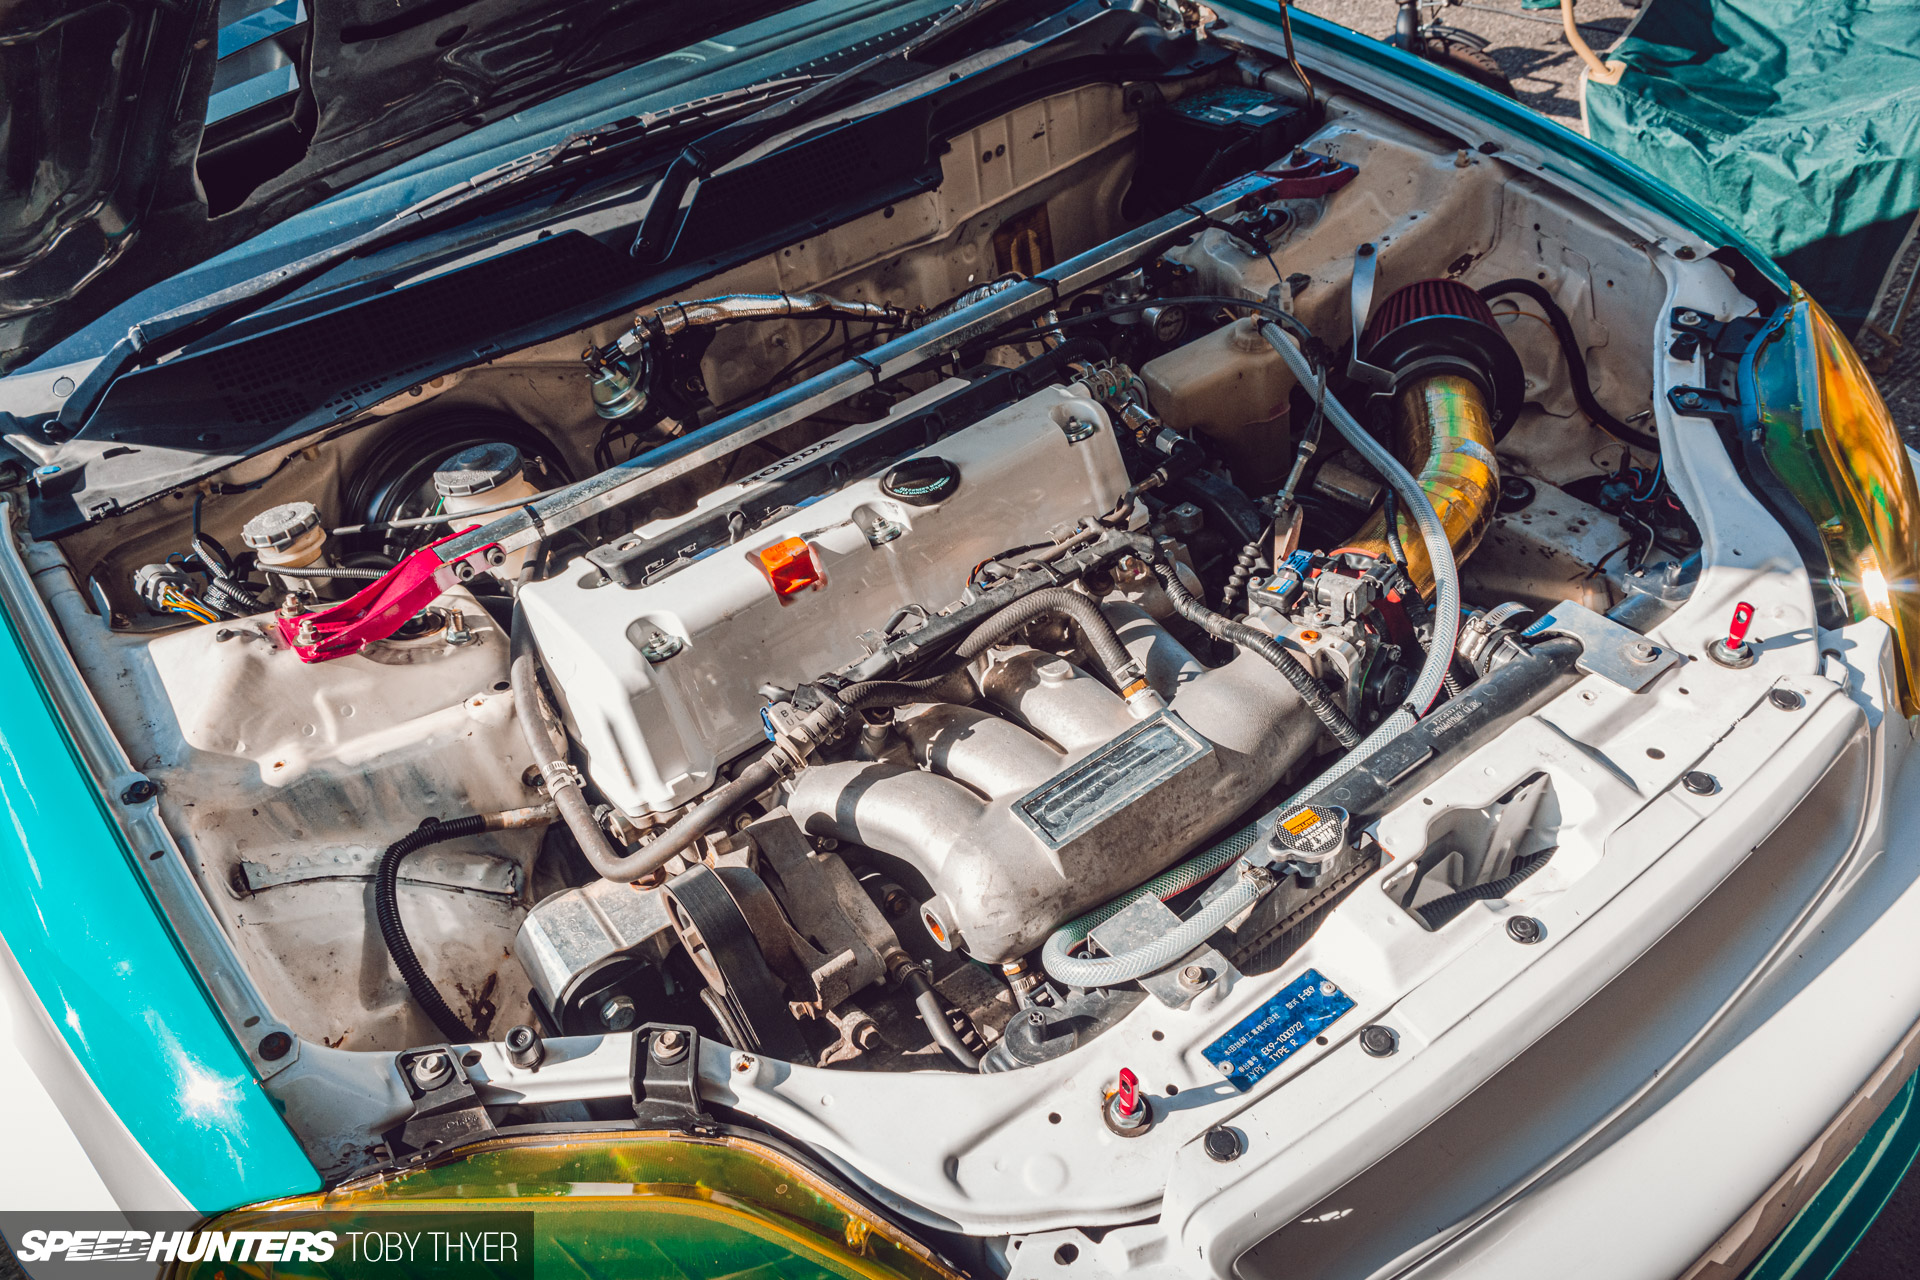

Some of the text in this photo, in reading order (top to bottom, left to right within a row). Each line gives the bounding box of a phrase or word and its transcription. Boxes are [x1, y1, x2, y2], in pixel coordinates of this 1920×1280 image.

[738, 440, 840, 489] HONDA
[1290, 815, 1318, 833] CAUTION
[1260, 1021, 1305, 1056] EK9-1000722
[1245, 1038, 1299, 1081] TYPE TYPE R
